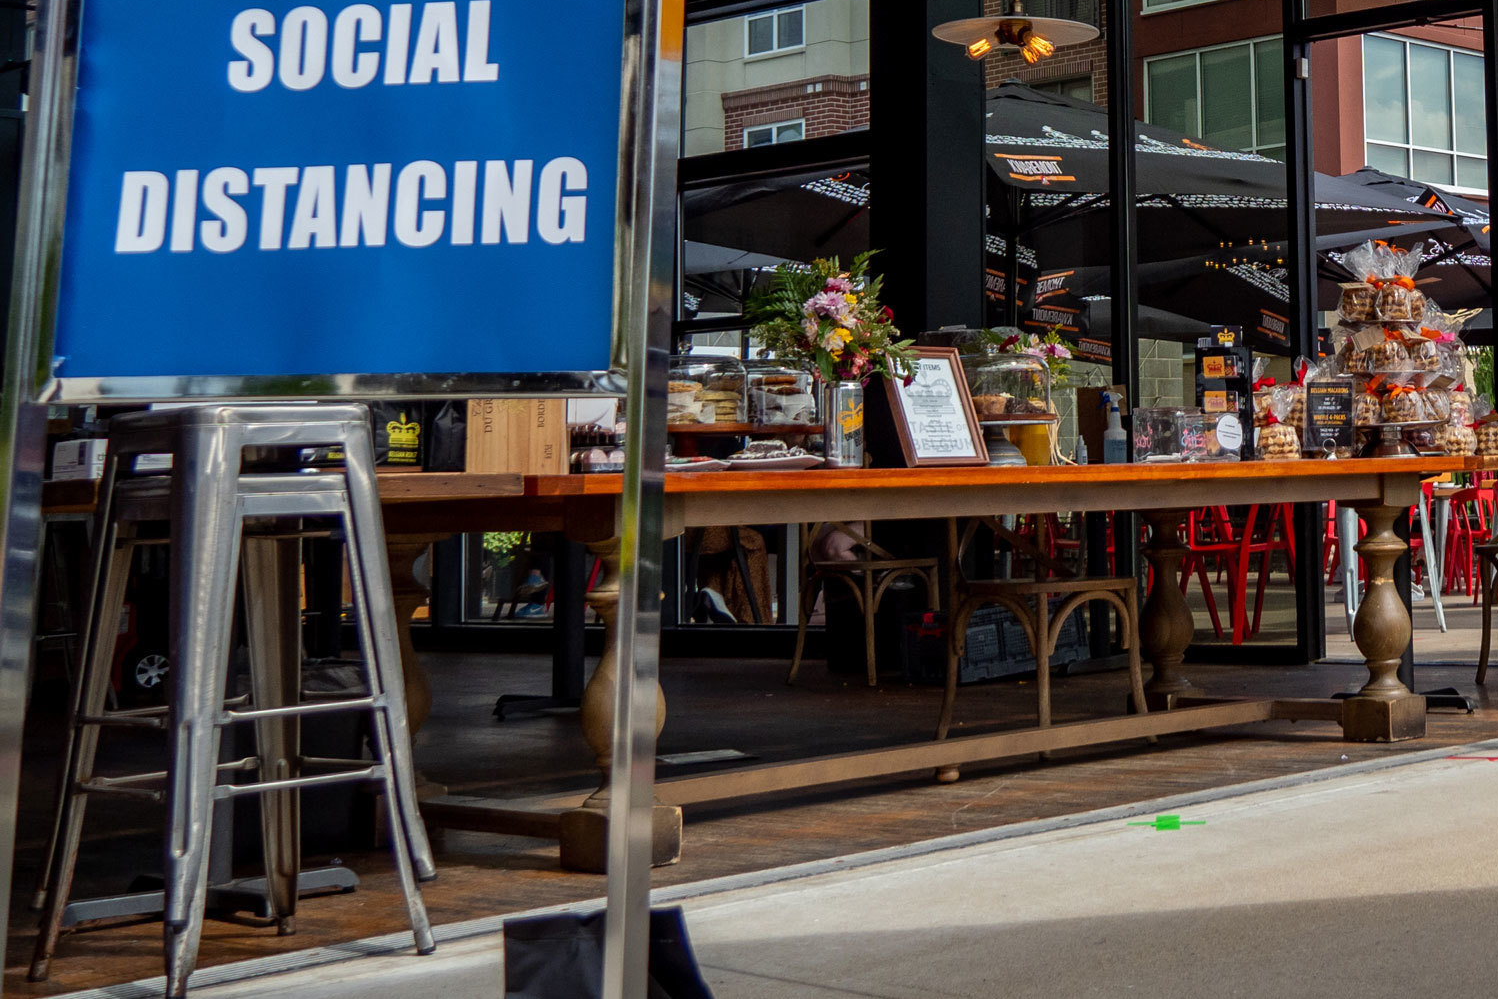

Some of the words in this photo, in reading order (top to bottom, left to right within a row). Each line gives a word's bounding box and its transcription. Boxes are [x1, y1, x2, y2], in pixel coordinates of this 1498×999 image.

[227, 0, 499, 93] SOCIAL
[1006, 158, 1063, 174] KWAREMONT
[114, 156, 588, 254] DISTANCING
[484, 418, 493, 433] DU
